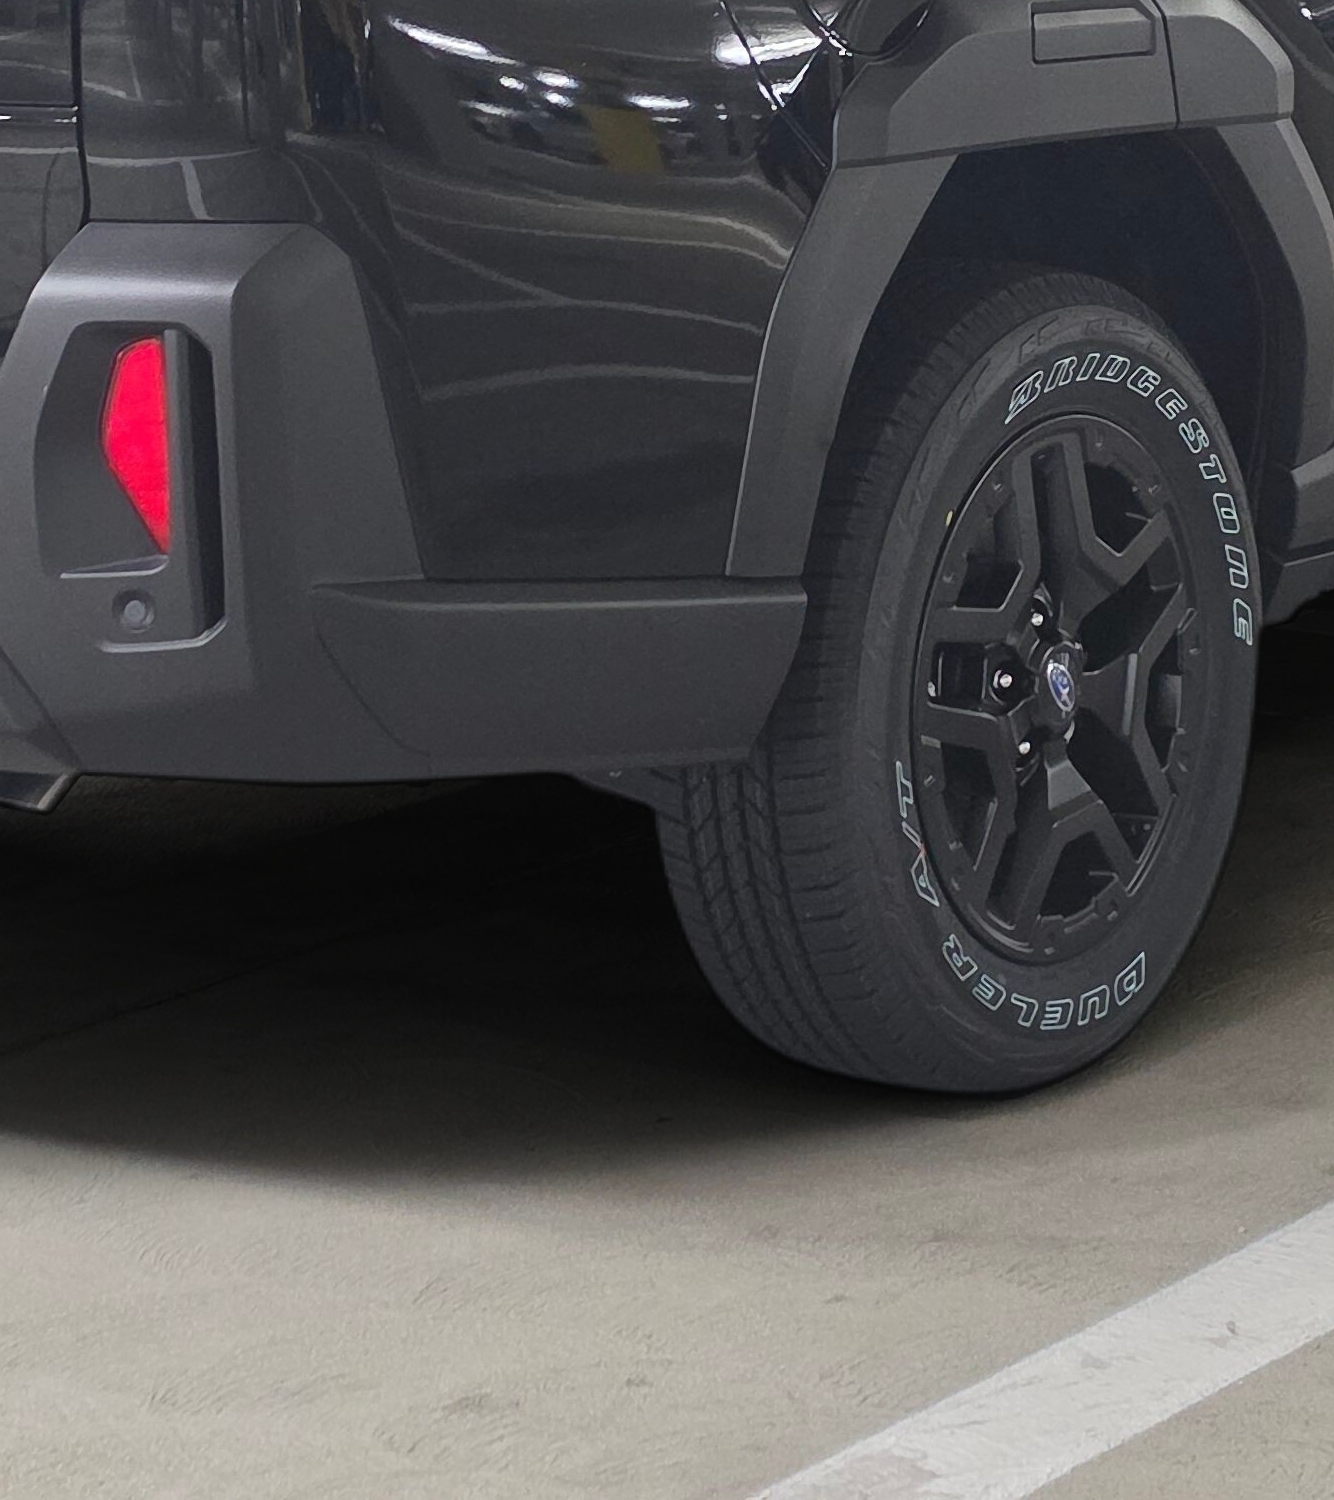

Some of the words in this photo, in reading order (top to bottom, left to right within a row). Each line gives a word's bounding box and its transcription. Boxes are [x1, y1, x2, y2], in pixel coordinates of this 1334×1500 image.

[1004, 353, 1254, 646] BRIDGESTONE
[895, 760, 940, 907] A/T
[942, 933, 1146, 1031] DUELER
